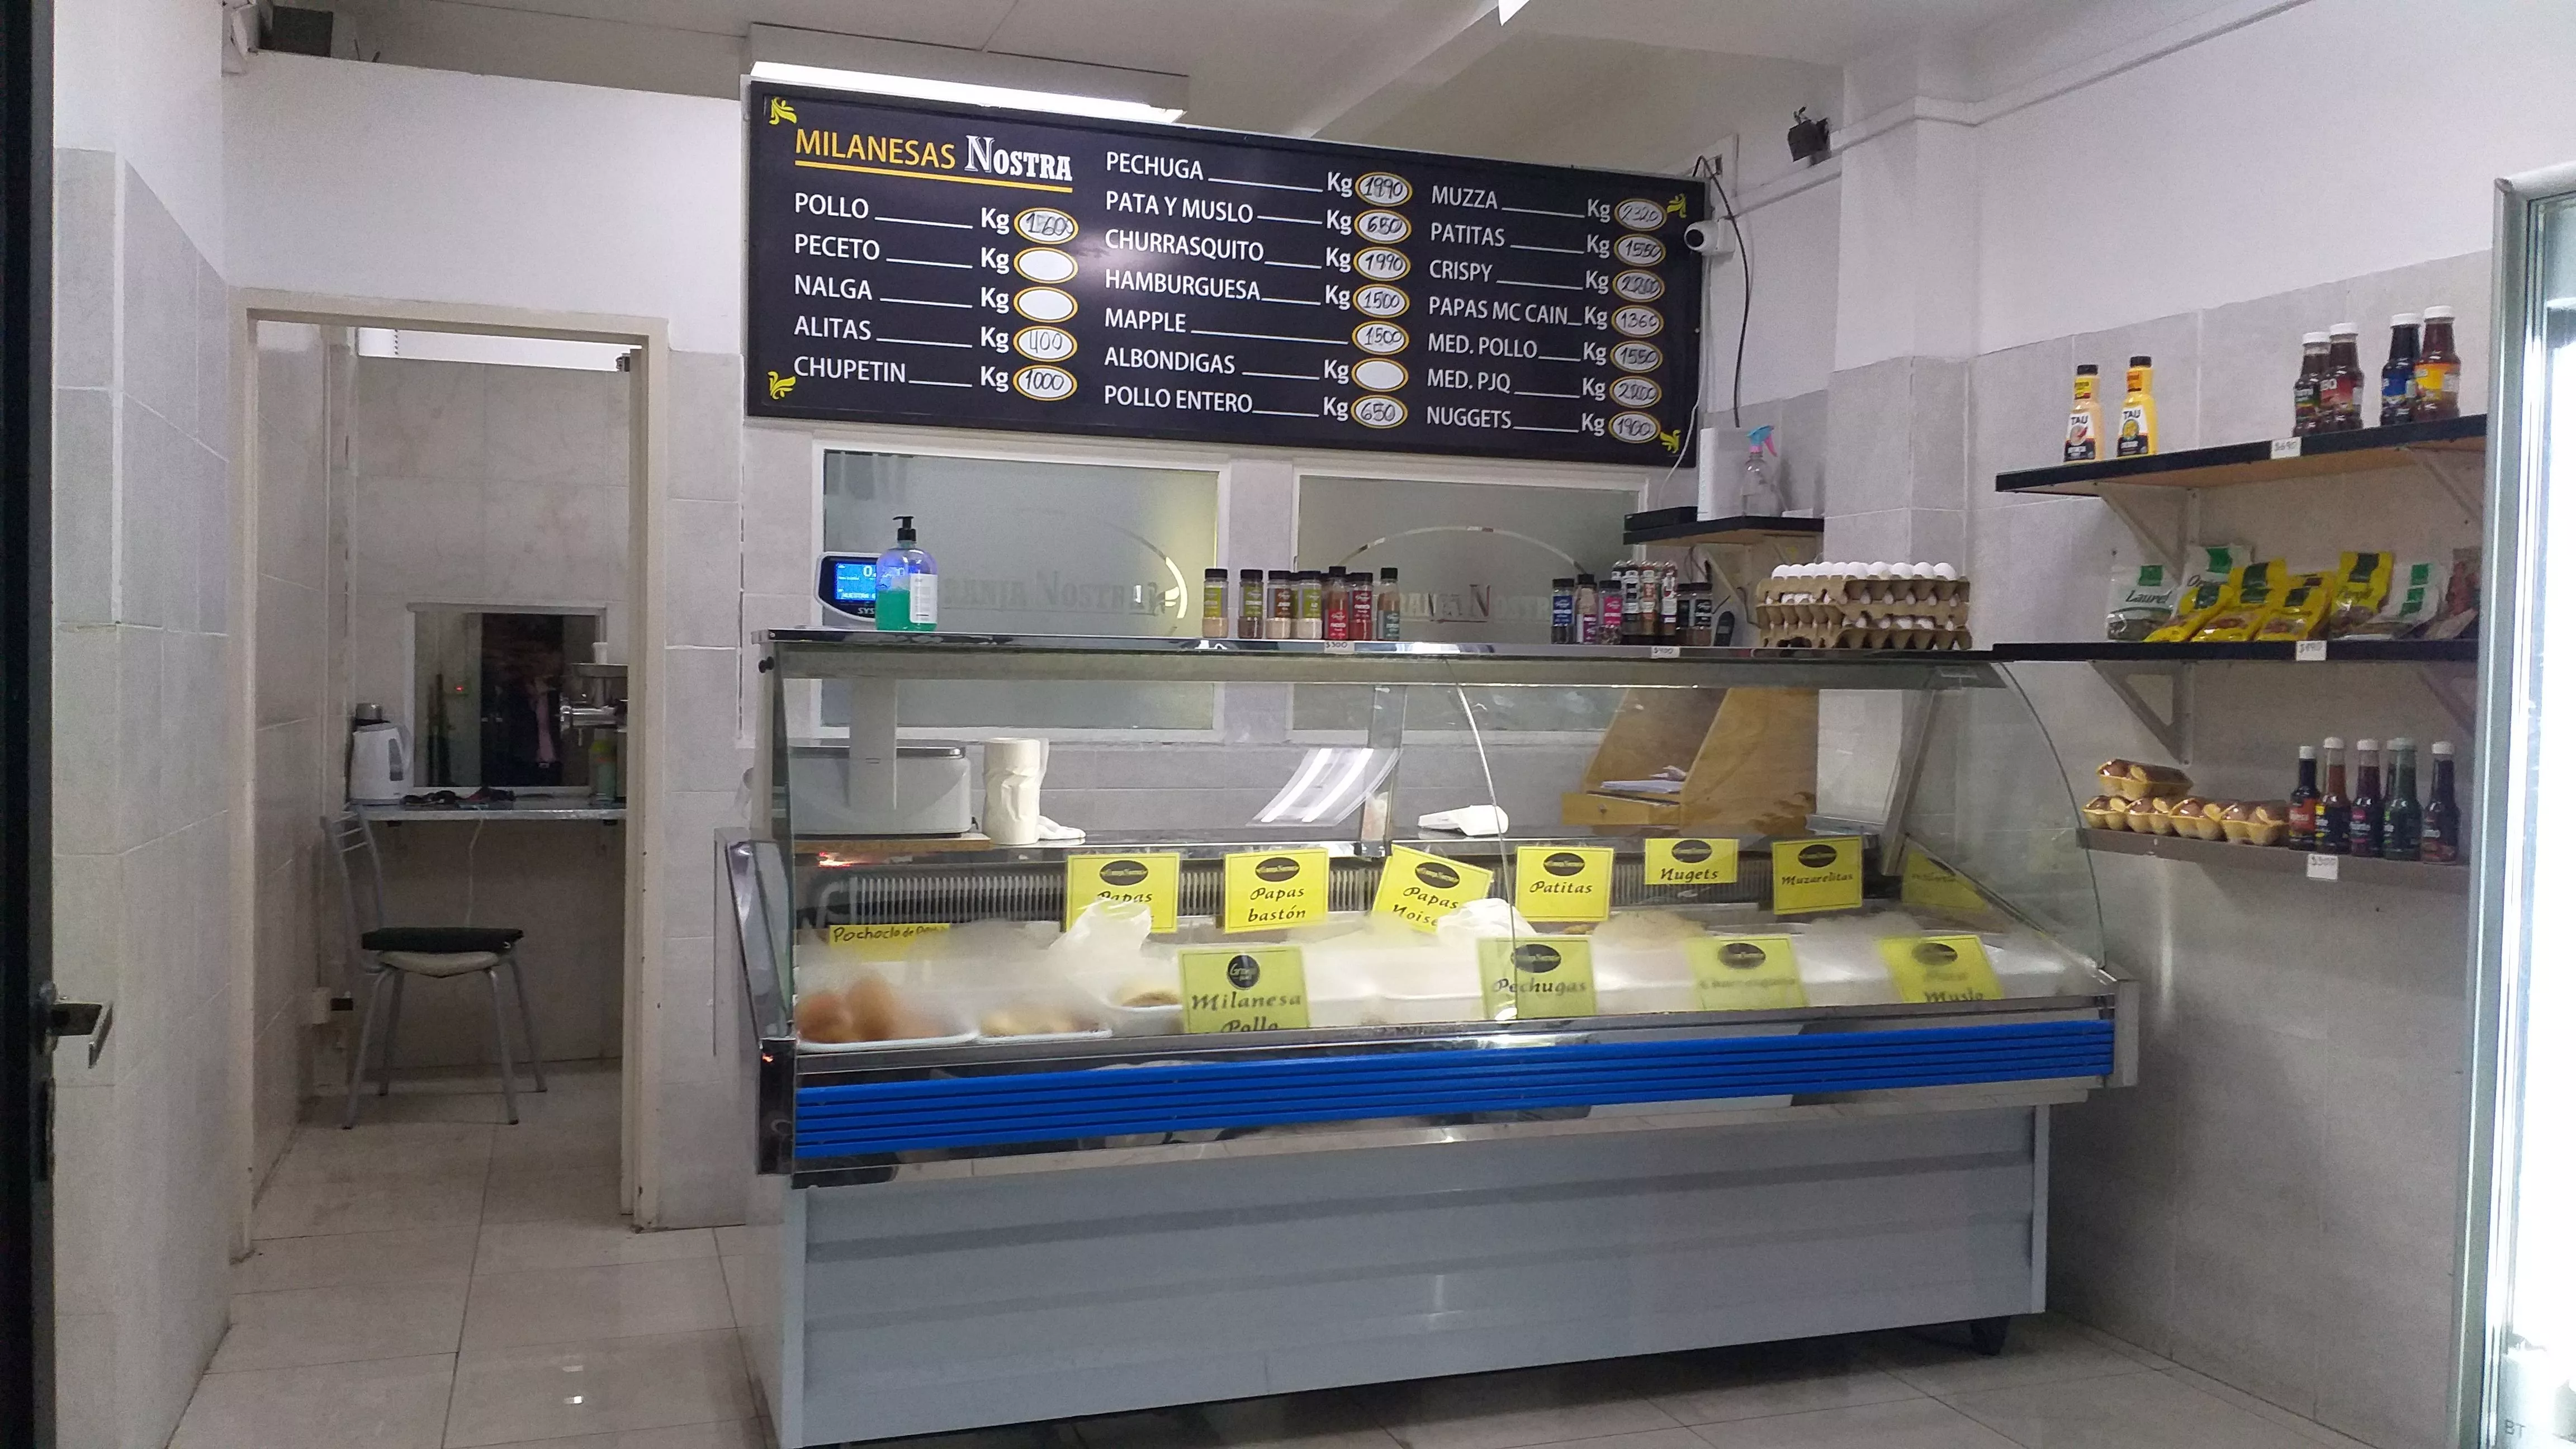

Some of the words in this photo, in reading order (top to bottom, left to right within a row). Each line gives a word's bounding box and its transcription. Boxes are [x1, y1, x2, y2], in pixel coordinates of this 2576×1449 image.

[795, 129, 955, 169] MILANESAS
[964, 135, 1073, 181] NOSTRA
[1107, 152, 1204, 181] PECHUGA
[1328, 172, 1353, 197] Kg
[1365, 177, 1403, 199] 1990
[795, 193, 869, 219] POLLO
[981, 208, 1010, 234] Kg
[1106, 191, 1159, 214] PATA
[1164, 197, 1178, 215] Y
[1182, 198, 1253, 223] MUSLO
[1327, 210, 1352, 235] Kg
[1432, 186, 1498, 209] MUZZA
[1588, 199, 1611, 222] Kg
[795, 234, 880, 260] PECETO
[981, 247, 1010, 275] Kg
[1105, 229, 1264, 262] CHURRASQUITO
[1326, 247, 1351, 273] Kg
[1365, 253, 1403, 272] 1990
[1431, 222, 1505, 247] PATITAS
[1587, 235, 1610, 258] Kg
[795, 274, 872, 300] NALGA
[981, 287, 1009, 314] Kg
[1106, 269, 1261, 301] HAMBURGUESA
[1325, 285, 1350, 310] Kg
[1363, 291, 1400, 309] 1500
[1429, 259, 1493, 282] CRISPY
[1585, 271, 1609, 294] Kg
[1105, 307, 1186, 333] MAPPLE
[1364, 326, 1402, 345] 1500
[1429, 296, 1488, 319] PAPAS
[1492, 302, 1521, 321] MC
[1525, 304, 1568, 325] CAIN
[1584, 306, 1608, 330] Kg
[794, 316, 872, 340] ALITAS
[981, 327, 1009, 353] Kg
[1428, 333, 1474, 354] MED.
[1479, 338, 1537, 359] POLLO
[1583, 342, 1607, 366] Kg
[794, 357, 906, 383] CHUPETIN
[981, 367, 1009, 393] Kg
[1026, 369, 1064, 390] 1000
[1104, 347, 1235, 375] ALBONDIGAS
[1324, 359, 1349, 385] Kg
[1427, 368, 1472, 390] MED.
[1478, 371, 1511, 394] PJQ
[1583, 377, 1606, 401] Kg
[1105, 385, 1171, 408] POLLO
[1176, 390, 1253, 414] ENTERO
[1323, 397, 1348, 422] Kg
[1427, 406, 1512, 429] NUGGETS
[1581, 413, 1606, 437] Kg
[1530, 880, 1593, 893] Patitas
[1660, 868, 1719, 883] Nugets
[1250, 887, 1305, 902] Papas
[1403, 887, 1459, 909] Papas
[1248, 905, 1306, 922] bastón
[1192, 991, 1302, 1012] Milanesa
[1492, 977, 1587, 996] Pechugas
